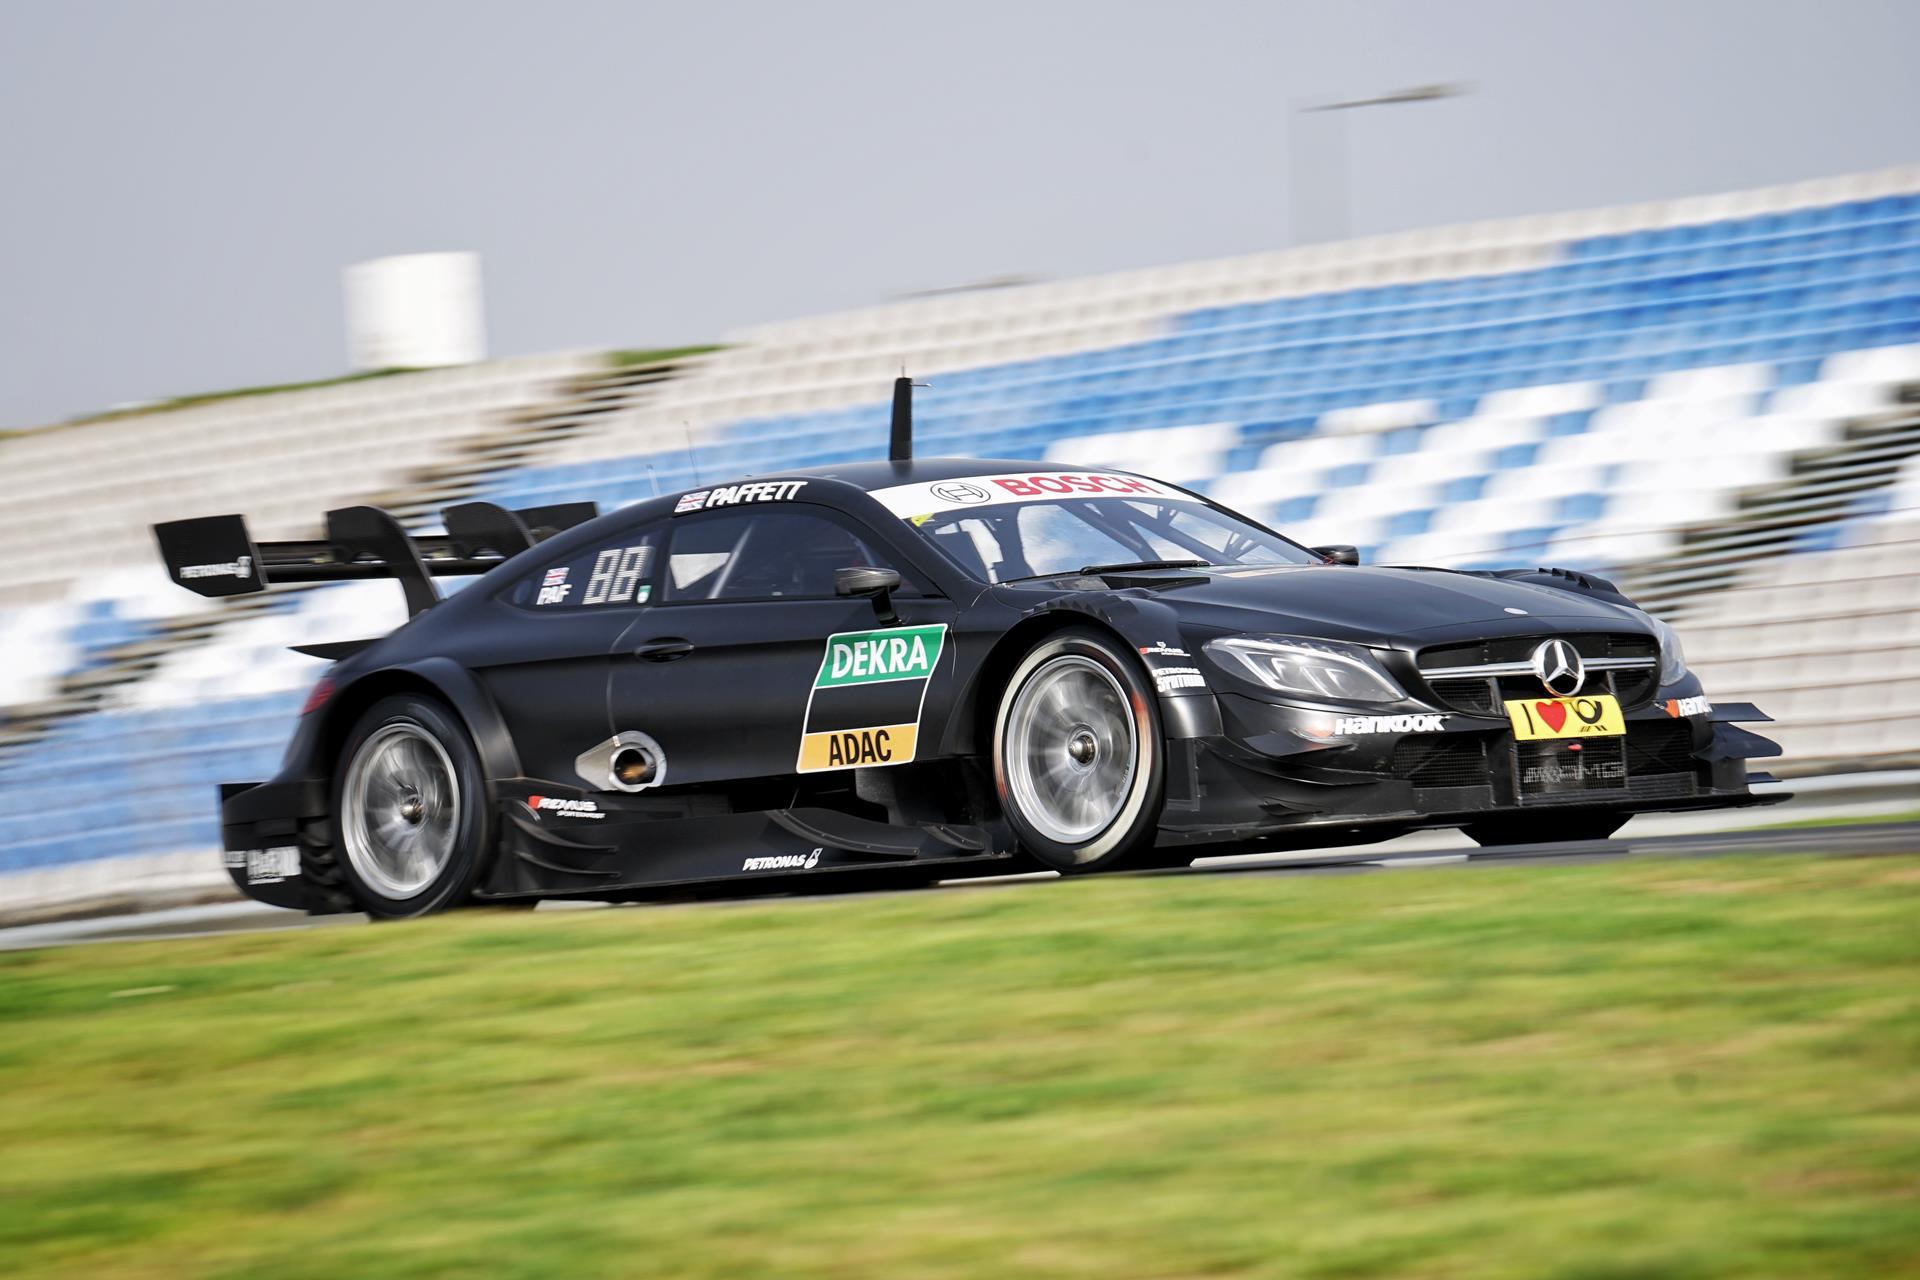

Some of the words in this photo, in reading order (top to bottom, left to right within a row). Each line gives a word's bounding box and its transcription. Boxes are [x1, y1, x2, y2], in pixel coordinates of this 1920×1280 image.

[706, 481, 808, 508] PAFFETT
[990, 475, 1164, 496] BOSCH
[536, 584, 573, 605] PAF
[831, 635, 928, 678] DEKRA
[1521, 703, 1535, 735] I
[829, 729, 892, 767] ADAC
[538, 797, 598, 811] REMUS
[742, 854, 807, 872] PETRONAS
